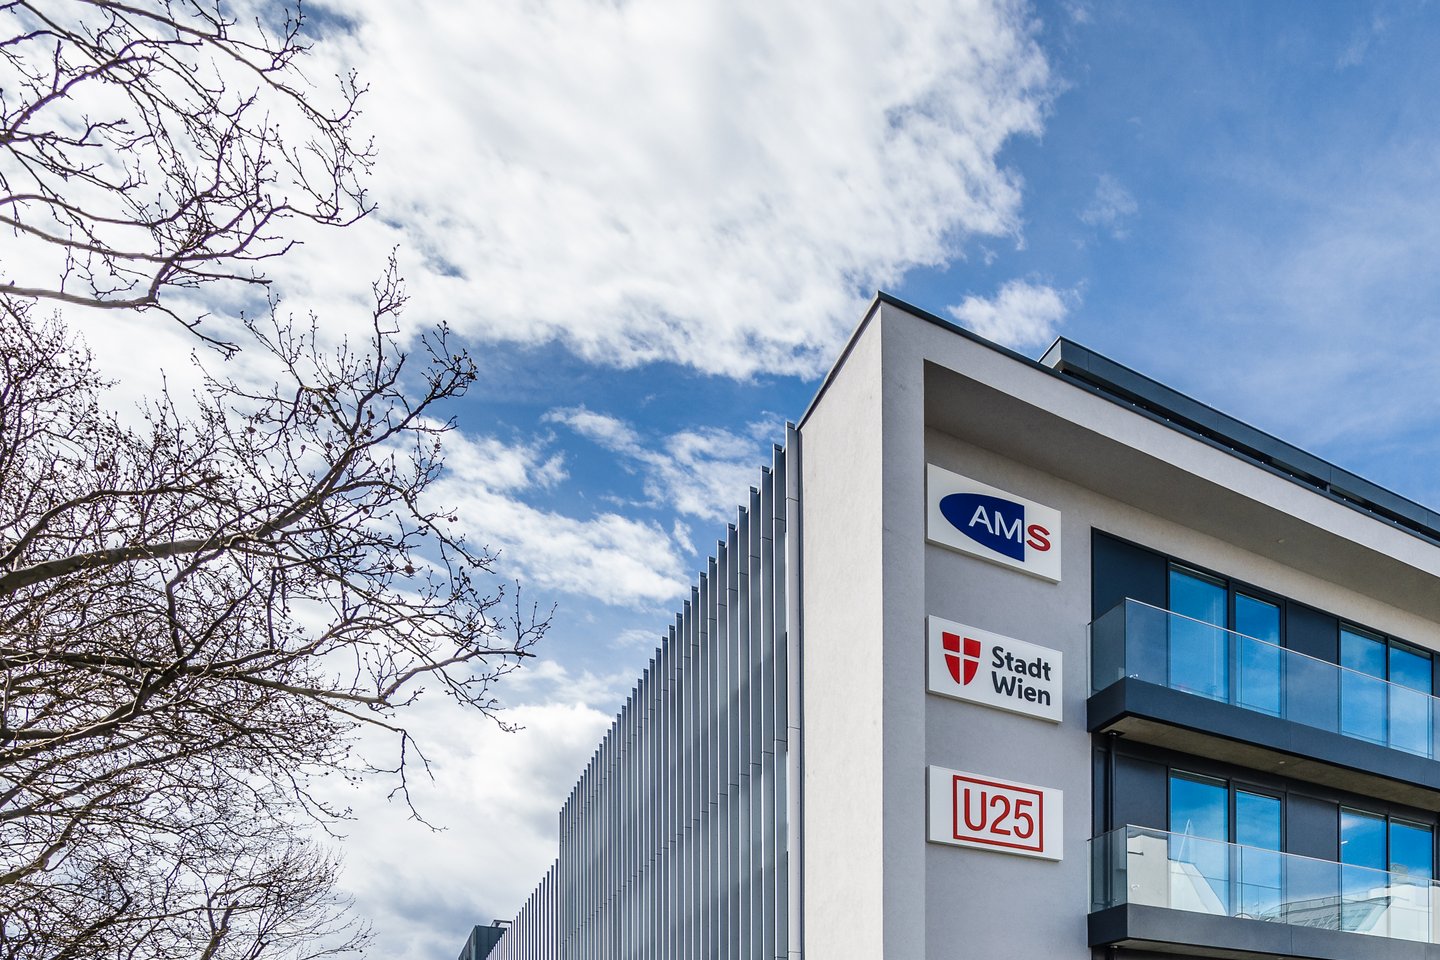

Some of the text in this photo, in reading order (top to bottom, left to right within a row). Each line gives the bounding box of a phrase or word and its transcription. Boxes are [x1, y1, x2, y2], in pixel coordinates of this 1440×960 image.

[968, 504, 1052, 552] AMS
[991, 645, 1052, 682] Stadt
[991, 670, 1052, 706] Wien
[963, 787, 1035, 841] U25
